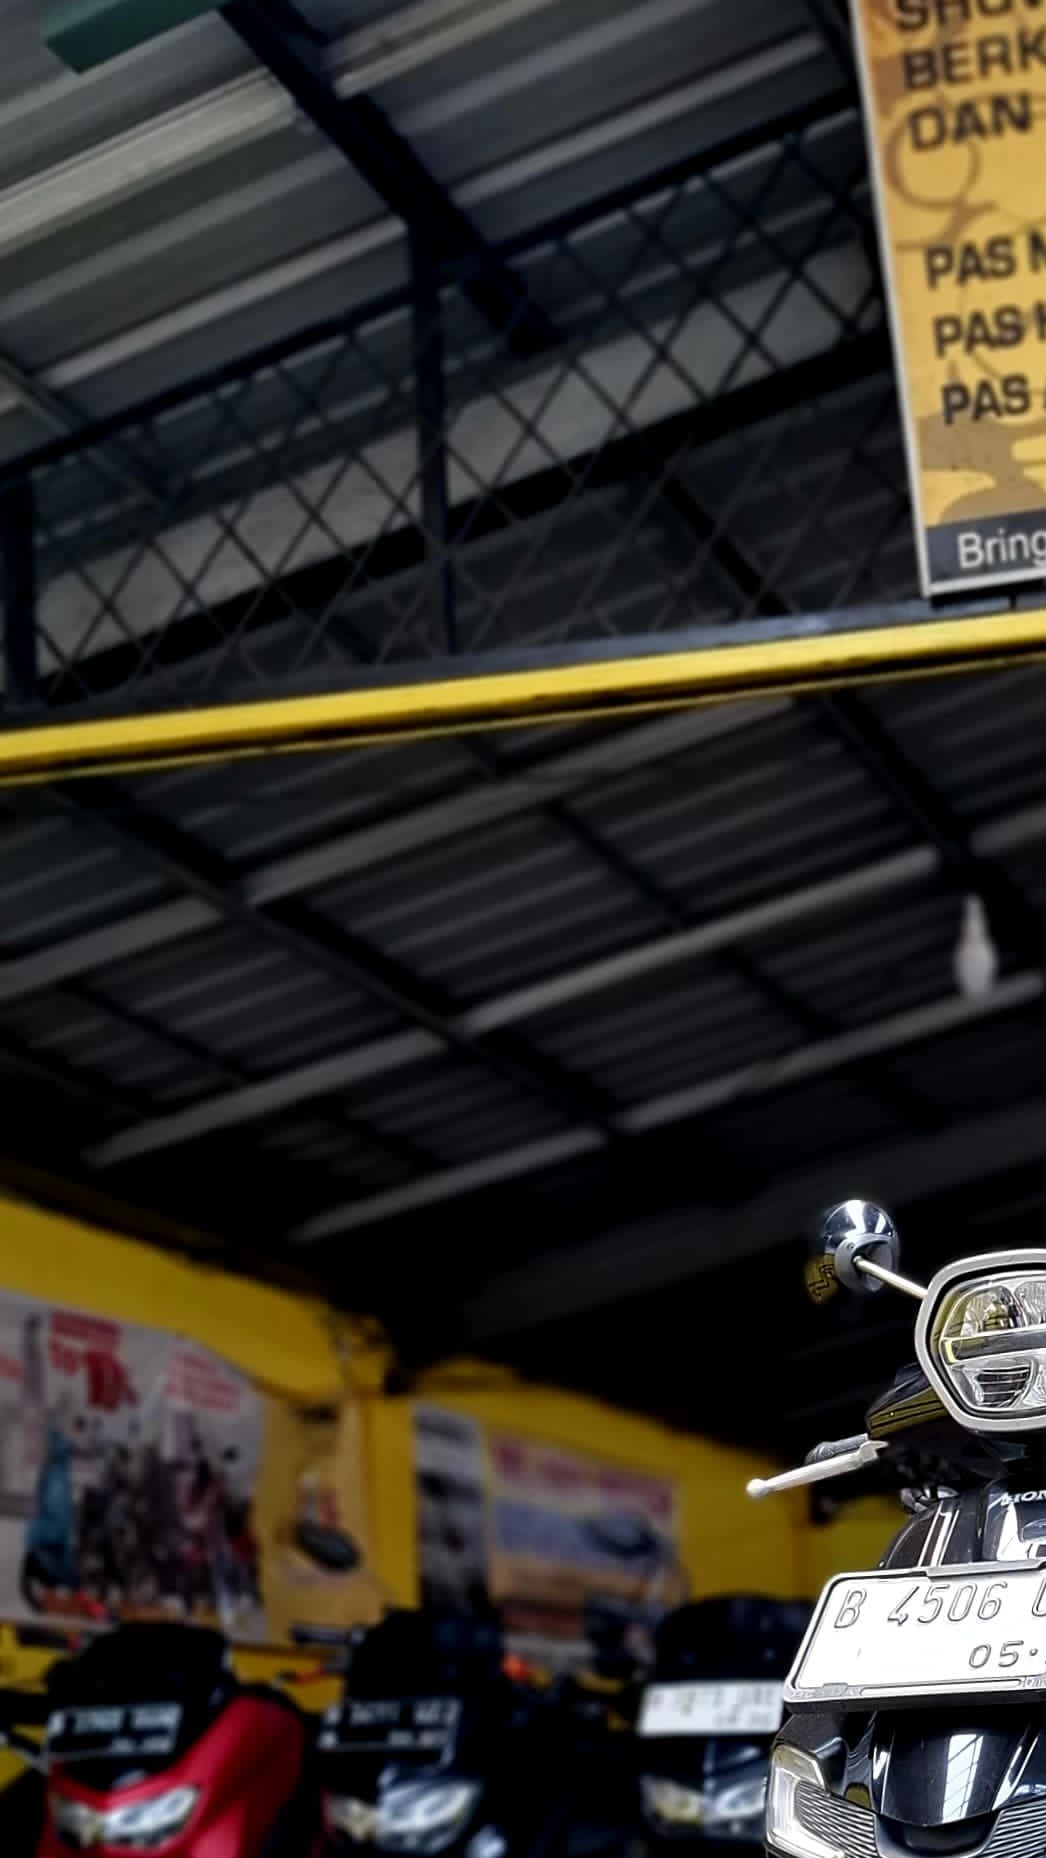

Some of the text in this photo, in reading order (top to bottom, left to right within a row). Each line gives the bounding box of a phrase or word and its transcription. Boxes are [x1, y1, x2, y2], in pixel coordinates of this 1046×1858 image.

[908, 94, 1032, 151] DAN
[925, 239, 1016, 289] PAS
[933, 305, 1024, 357] PAS
[941, 375, 1031, 424] PAS
[834, 1588, 865, 1629] B
[887, 1582, 1008, 1627] 4506
